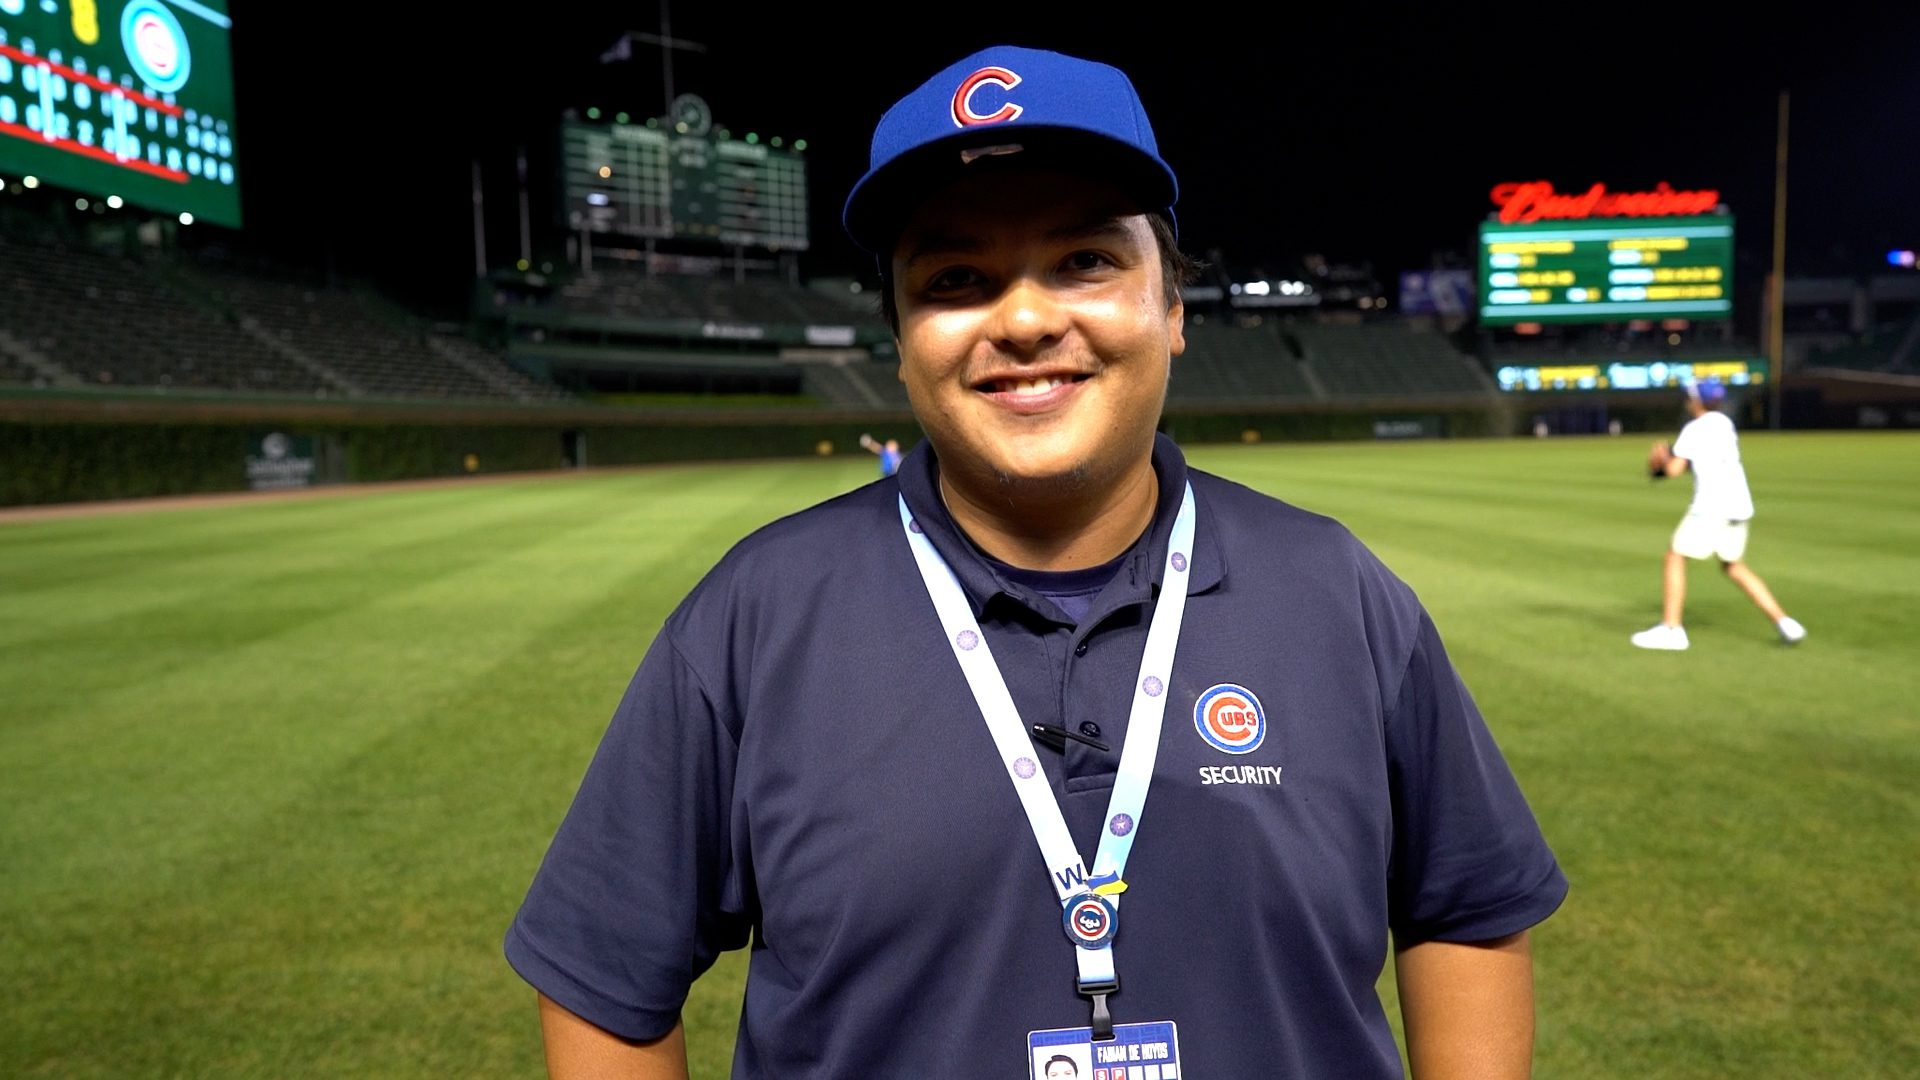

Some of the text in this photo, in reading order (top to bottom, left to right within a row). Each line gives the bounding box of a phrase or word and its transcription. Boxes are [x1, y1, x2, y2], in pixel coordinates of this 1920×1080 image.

[951, 66, 1024, 128] C
[1490, 180, 1719, 224] Budweiser
[1208, 696, 1256, 741] CUBS
[1199, 765, 1282, 785] SECURITY
[1055, 863, 1083, 890] W
[1097, 1045, 1127, 1064] FABIAN
[1128, 1044, 1140, 1060] DE
